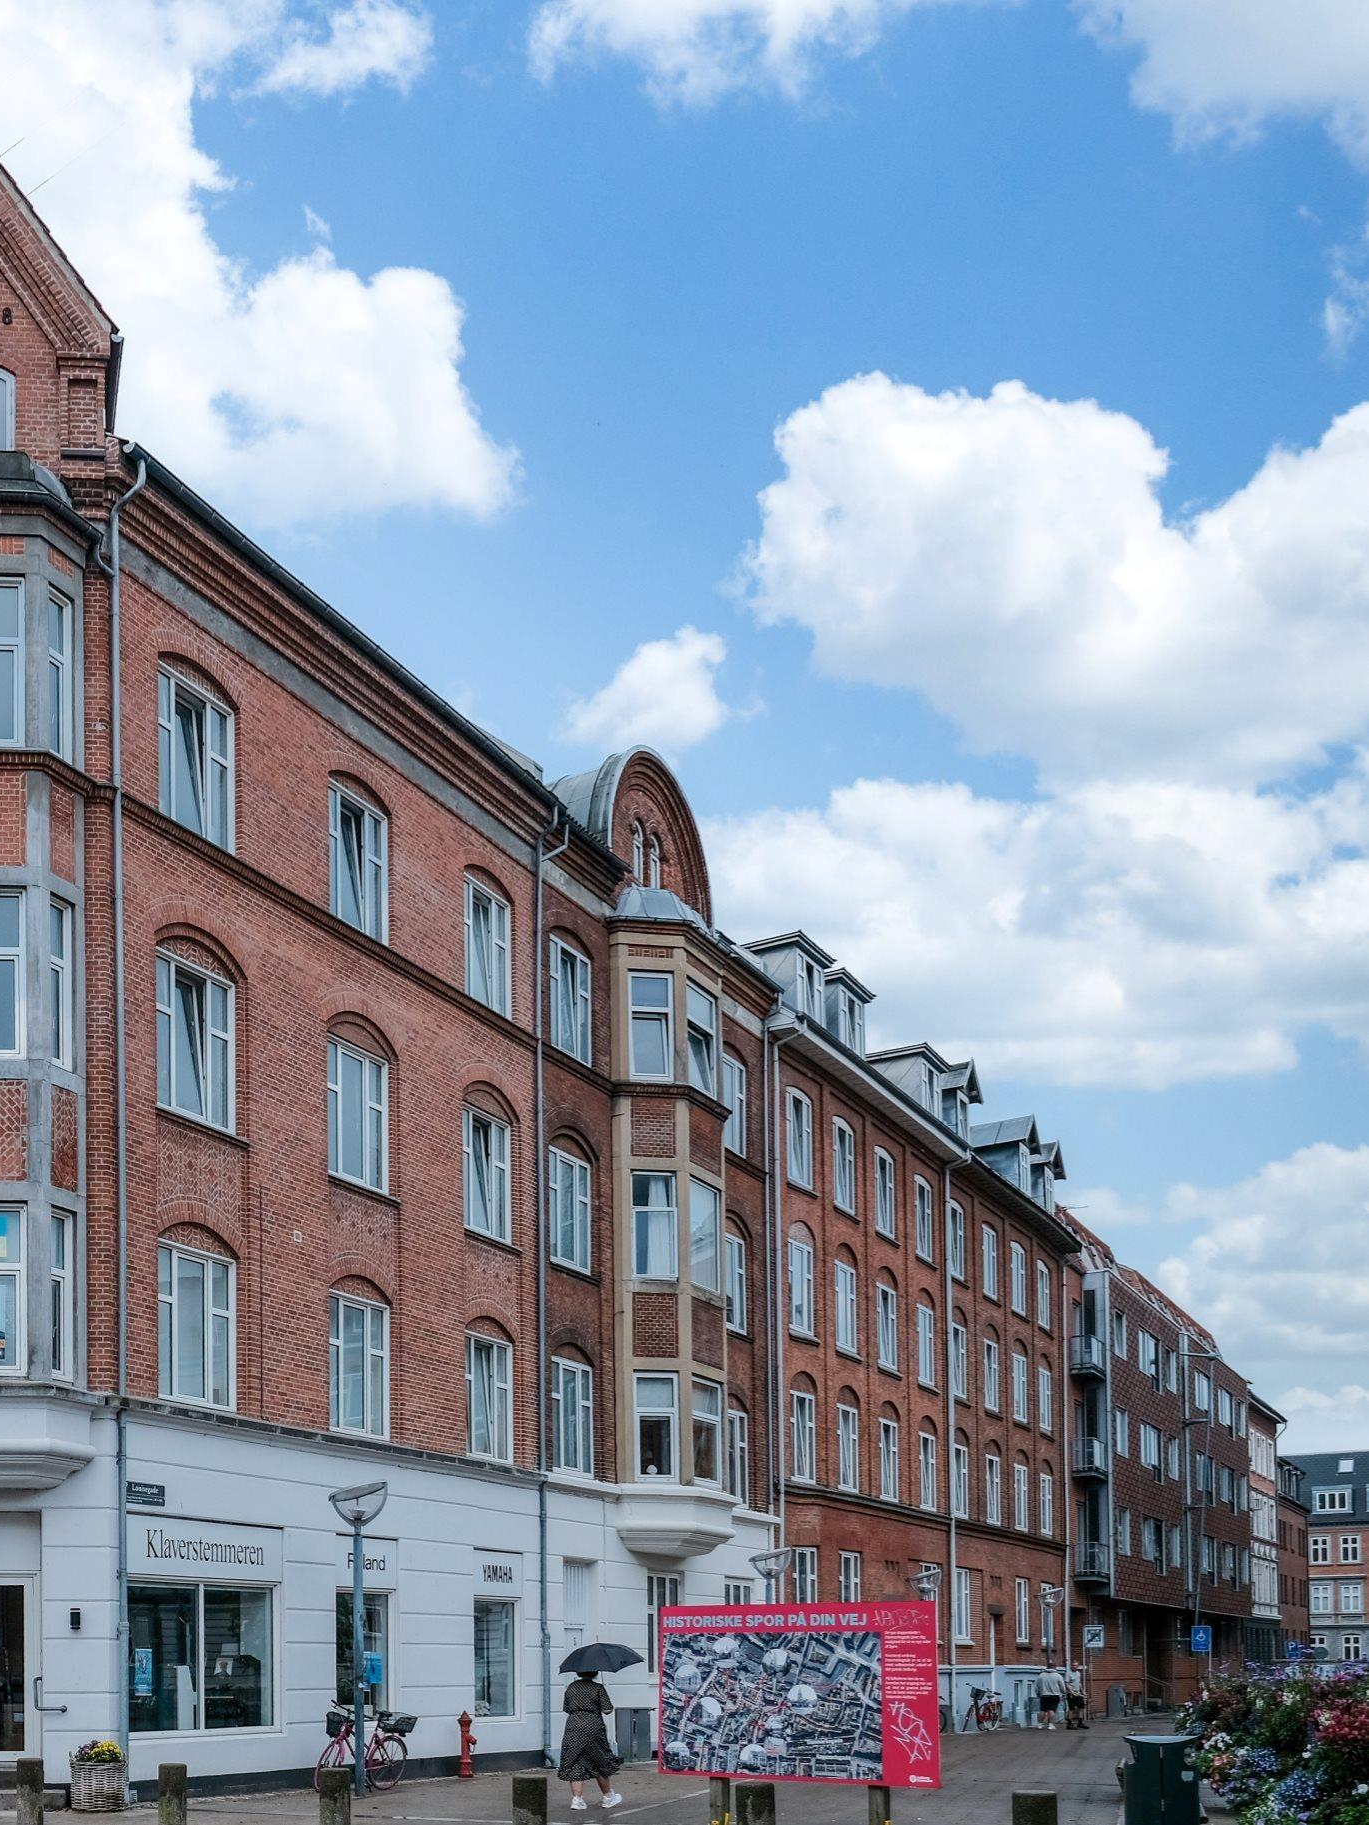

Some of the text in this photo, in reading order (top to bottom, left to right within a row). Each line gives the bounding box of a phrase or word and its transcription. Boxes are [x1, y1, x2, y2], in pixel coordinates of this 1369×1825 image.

[146, 1529, 264, 1565] Klaverstemmeren
[482, 1564, 513, 1583] YAMAHA
[662, 1615, 743, 1628] HISTORISKE
[745, 1614, 785, 1627] SPOR
[787, 1611, 807, 1626] PÅ
[809, 1613, 836, 1626] DIN
[838, 1613, 867, 1626] VEJ
